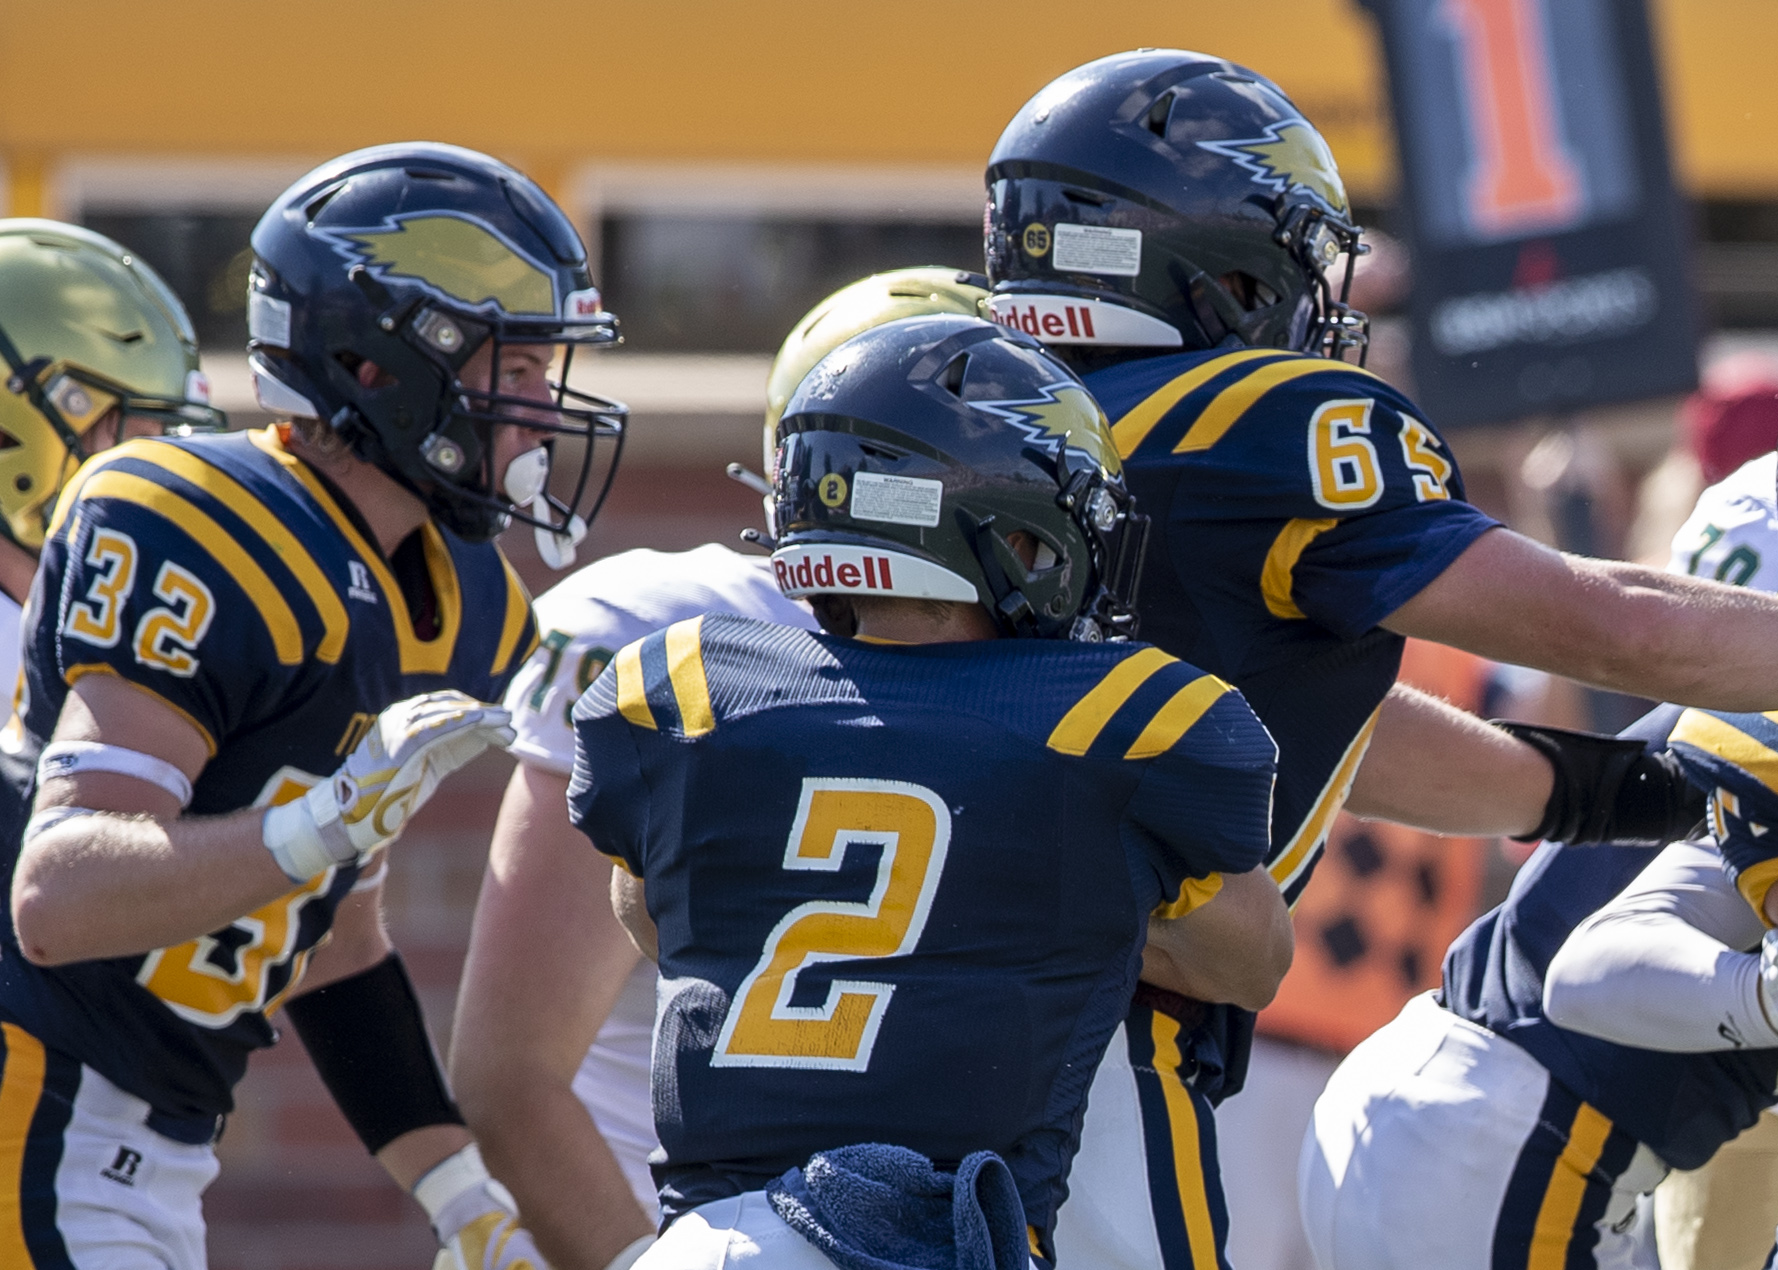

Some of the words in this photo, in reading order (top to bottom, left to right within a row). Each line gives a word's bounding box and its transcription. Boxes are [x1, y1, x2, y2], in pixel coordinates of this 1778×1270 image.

[1027, 229, 1048, 249] 65
[826, 480, 838, 500] 2
[1307, 398, 1452, 511] 65
[63, 526, 217, 679] 32
[774, 555, 893, 593] Riddell
[712, 778, 951, 1071] 2
